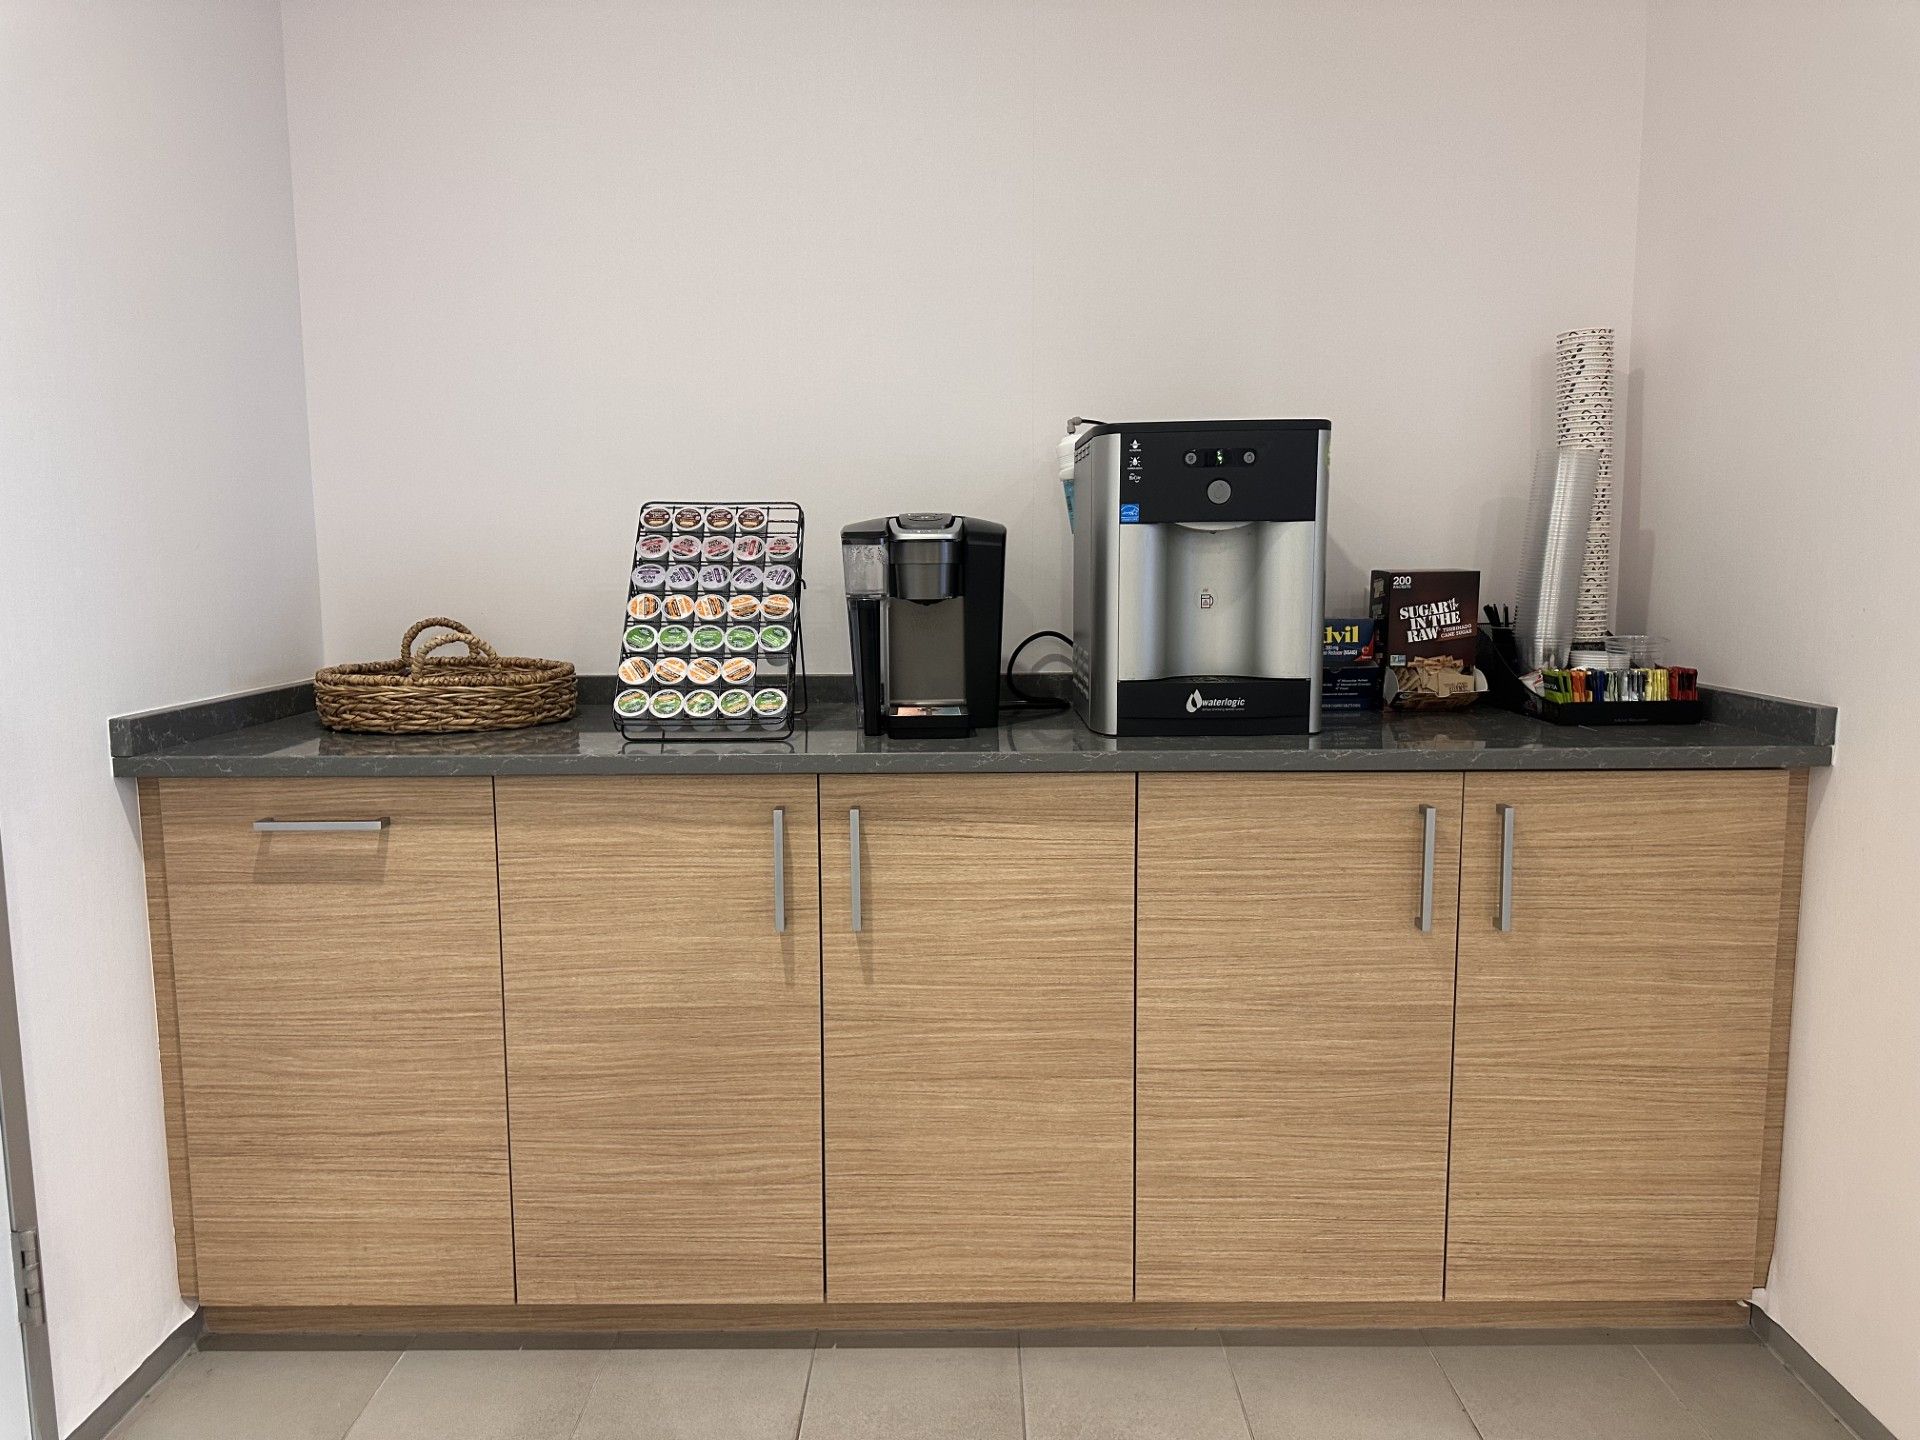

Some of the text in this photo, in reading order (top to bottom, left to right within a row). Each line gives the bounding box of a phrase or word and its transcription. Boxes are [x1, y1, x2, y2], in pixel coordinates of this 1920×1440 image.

[1393, 576, 1411, 585] 200
[1400, 601, 1449, 620] SUGAR
[1410, 611, 1461, 630] IN THE
[1323, 625, 1359, 643] dvil
[1407, 626, 1439, 642] RAW
[1202, 697, 1246, 707] waterlogic
